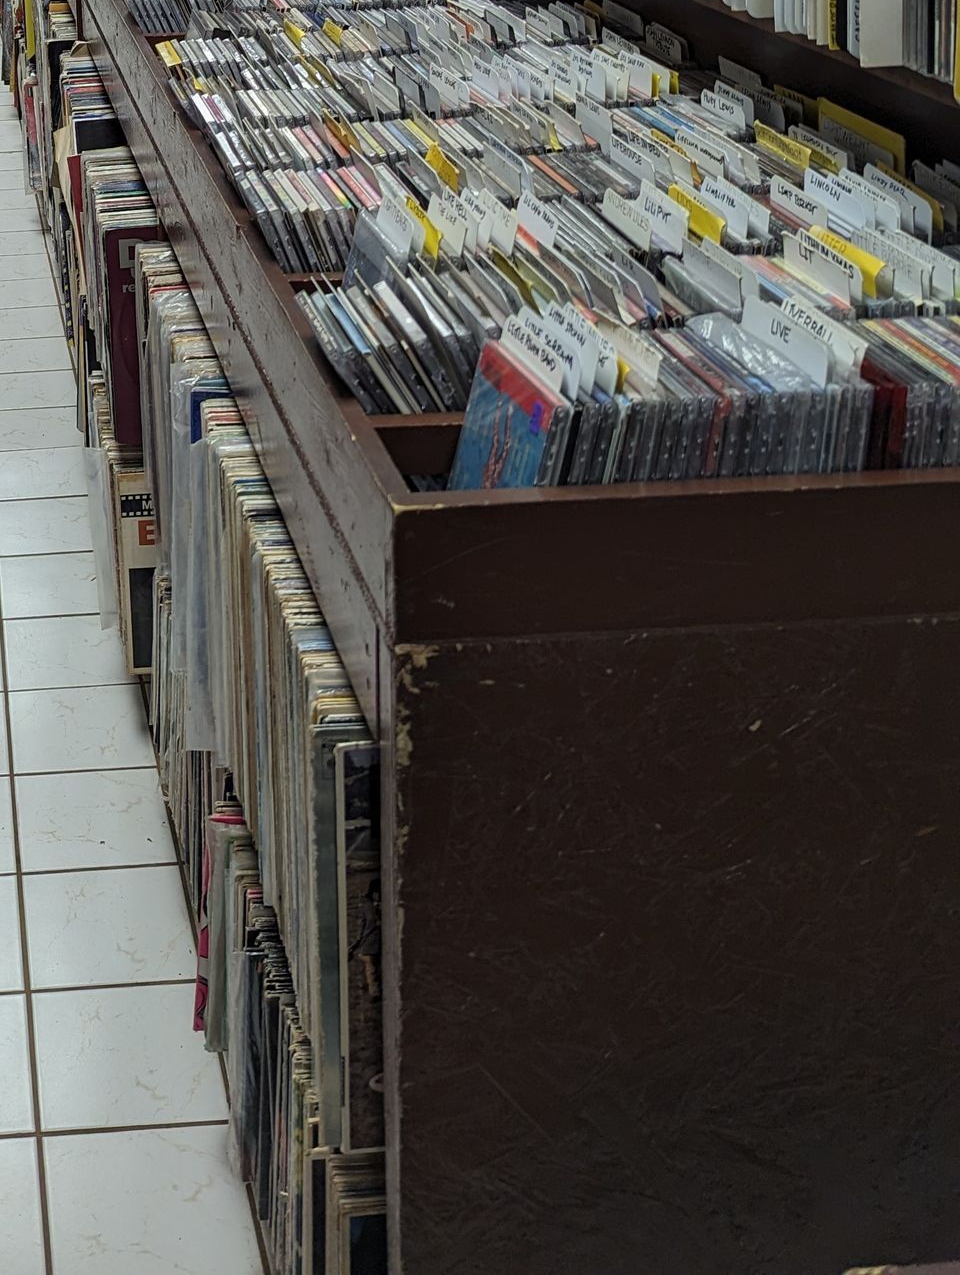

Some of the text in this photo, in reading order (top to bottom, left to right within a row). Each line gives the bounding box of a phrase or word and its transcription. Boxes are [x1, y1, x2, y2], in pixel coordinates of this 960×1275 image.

[777, 182, 794, 202] LIMP
[810, 172, 842, 203] LINCOLN
[798, 243, 815, 265] LIT
[770, 318, 792, 344] LIVE
